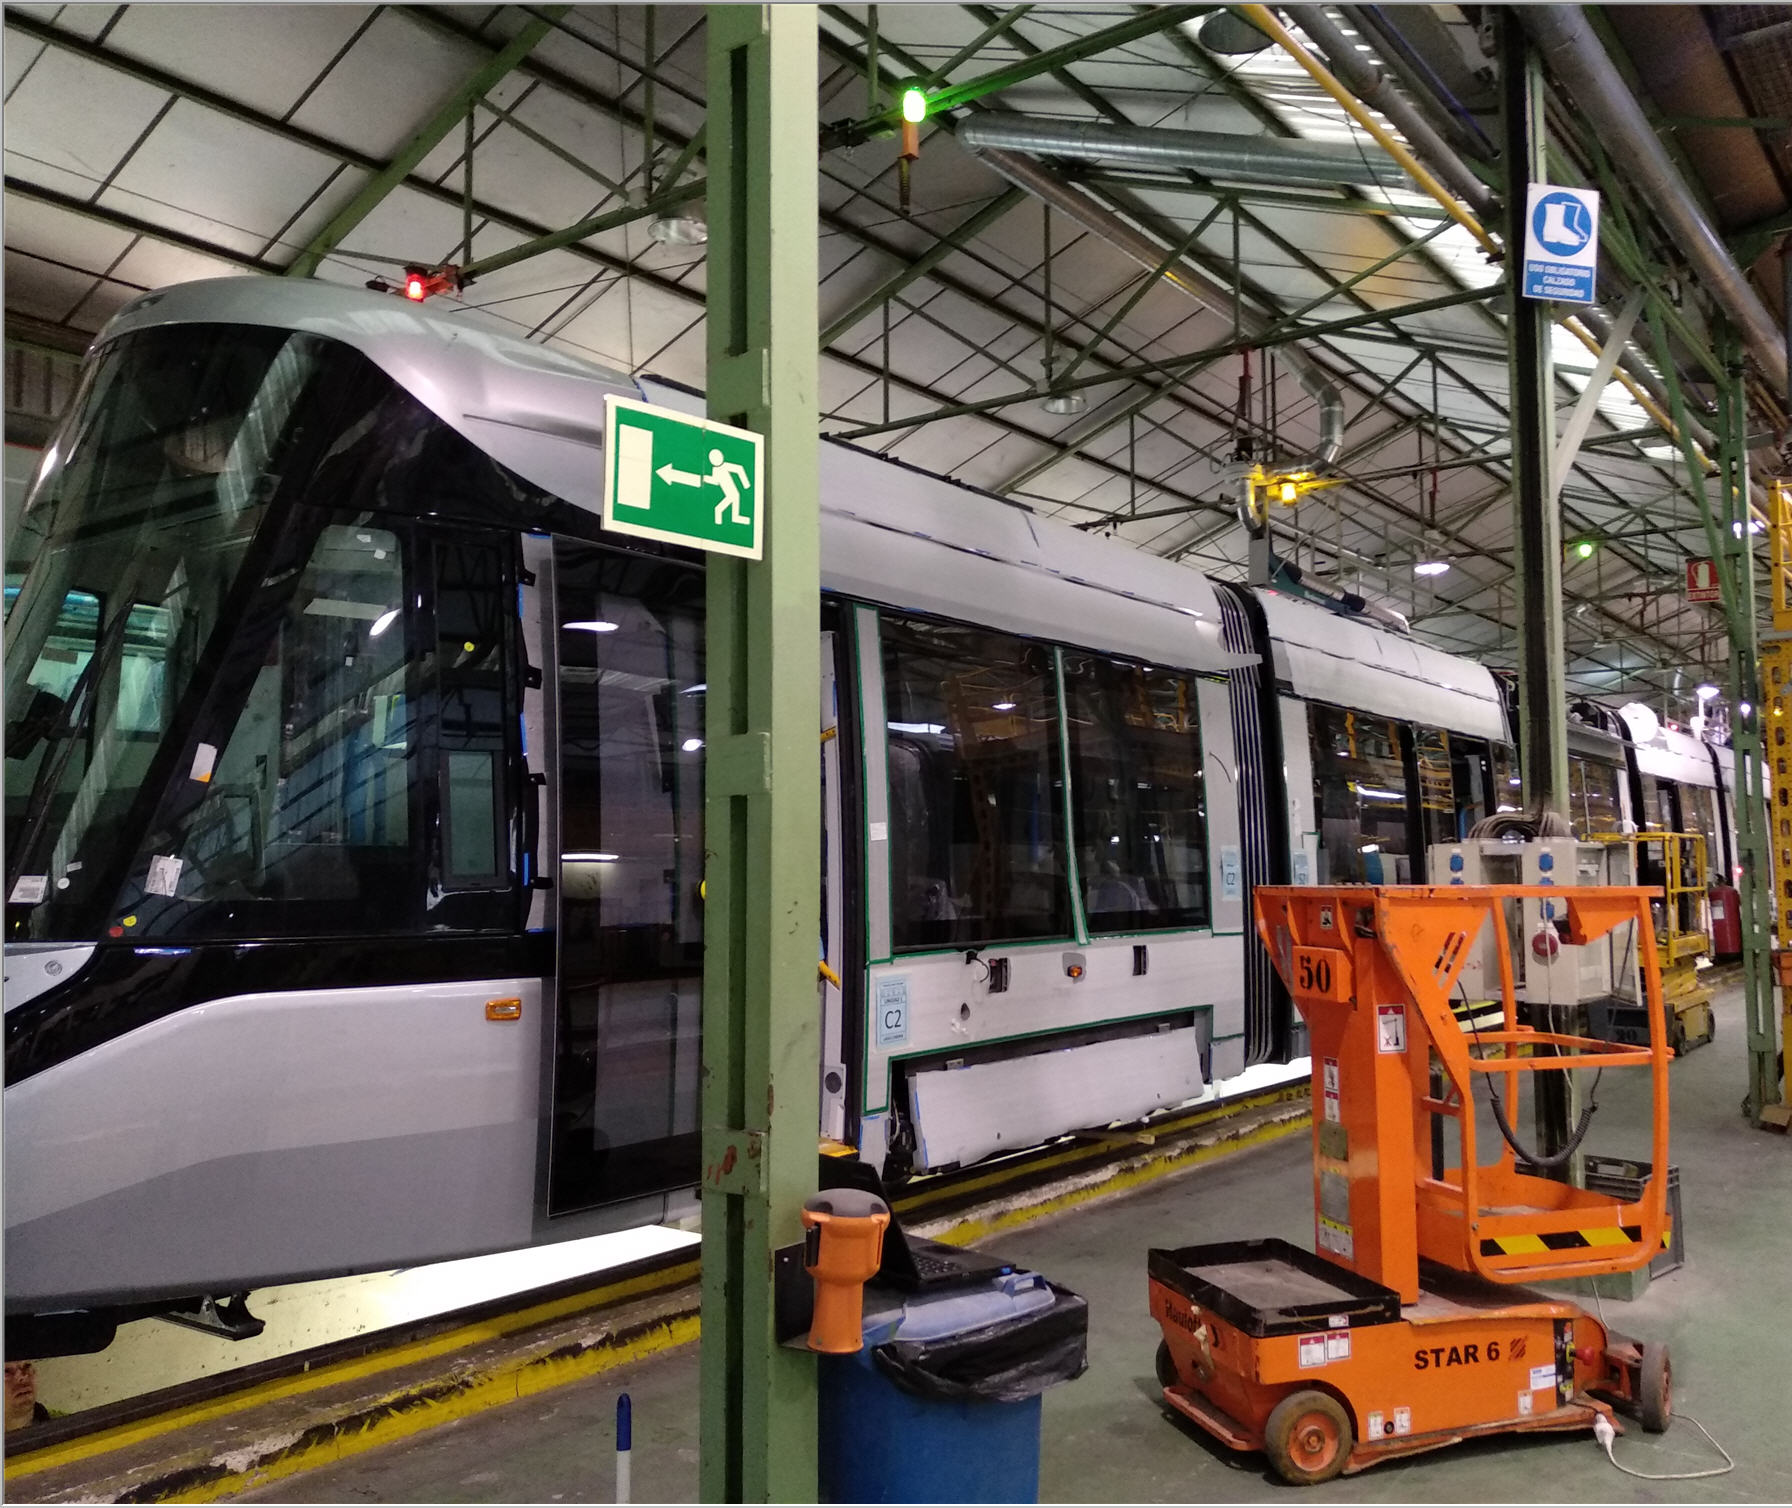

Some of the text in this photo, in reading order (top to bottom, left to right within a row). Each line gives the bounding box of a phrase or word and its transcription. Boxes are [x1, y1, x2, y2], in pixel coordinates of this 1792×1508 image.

[1300, 955, 1331, 993] 50
[884, 1009, 902, 1029] C2
[1414, 1341, 1500, 1370] STAR 6
